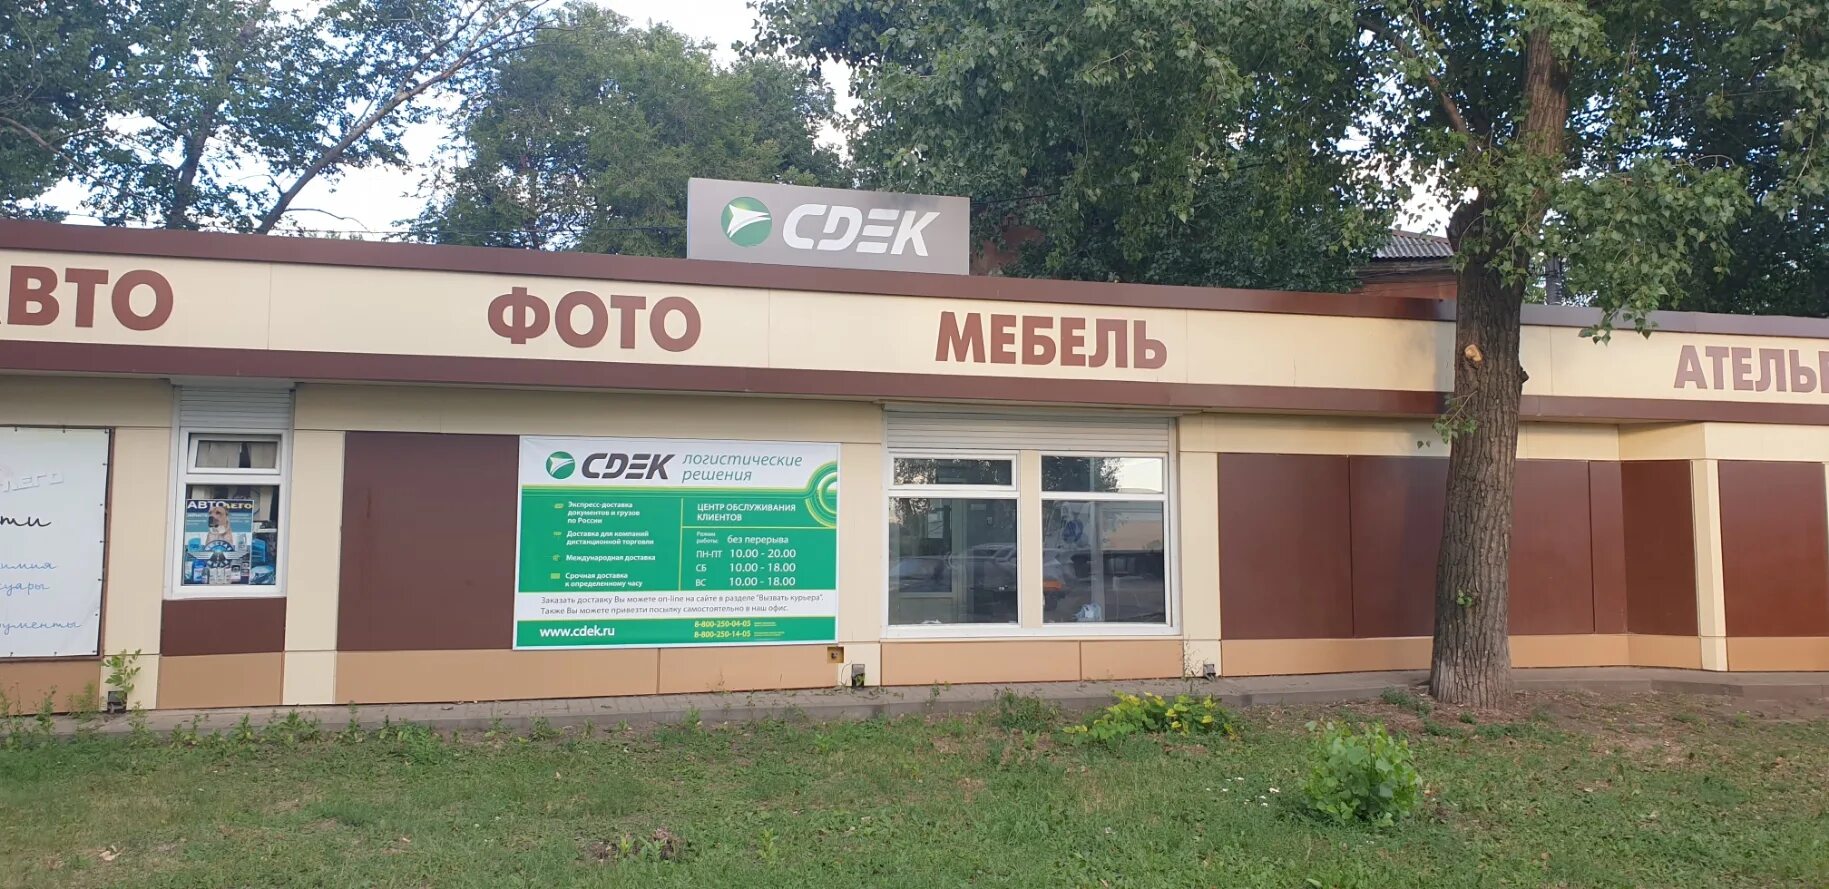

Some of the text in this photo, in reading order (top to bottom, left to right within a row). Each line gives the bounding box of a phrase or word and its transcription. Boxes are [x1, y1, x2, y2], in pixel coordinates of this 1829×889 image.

[782, 203, 941, 257] CDEK
[0, 265, 174, 331] ВТО
[487, 286, 702, 353] ФОТО
[935, 310, 1168, 370] МЕБЕЛЬ
[681, 452, 803, 468] логистические
[581, 452, 676, 480] CDEK
[681, 468, 753, 484] решения
[568, 501, 634, 509] Экспресс-доставка
[697, 503, 796, 512] ЦЕНТР ОБСЛУЖИВАНИЯ
[0, 515, 52, 527] ти
[697, 513, 743, 522] КЛИЕНТОВ
[727, 535, 789, 546] без перерыва
[566, 554, 624, 562] Международная
[696, 550, 723, 558] ПН-ПТ
[730, 549, 759, 558] 10.00
[767, 549, 797, 558] 20.00
[0, 562, 57, 570] имия
[695, 564, 707, 572] СБ
[730, 563, 758, 572] 10.00
[768, 563, 796, 572] 18.00
[565, 572, 596, 580] Срочная
[695, 579, 707, 587] ВС
[729, 577, 758, 586] 10.00
[768, 577, 796, 586] 18.00
[540, 596, 576, 604] Заказать
[577, 596, 612, 605] доставку
[614, 595, 626, 603] Вы
[725, 595, 756, 603] разделе
[540, 607, 565, 615] Также
[610, 607, 648, 615] привезти
[649, 606, 681, 614] посылку
[683, 605, 744, 613] самостоятельно
[539, 624, 615, 637] www.cdek.ru
